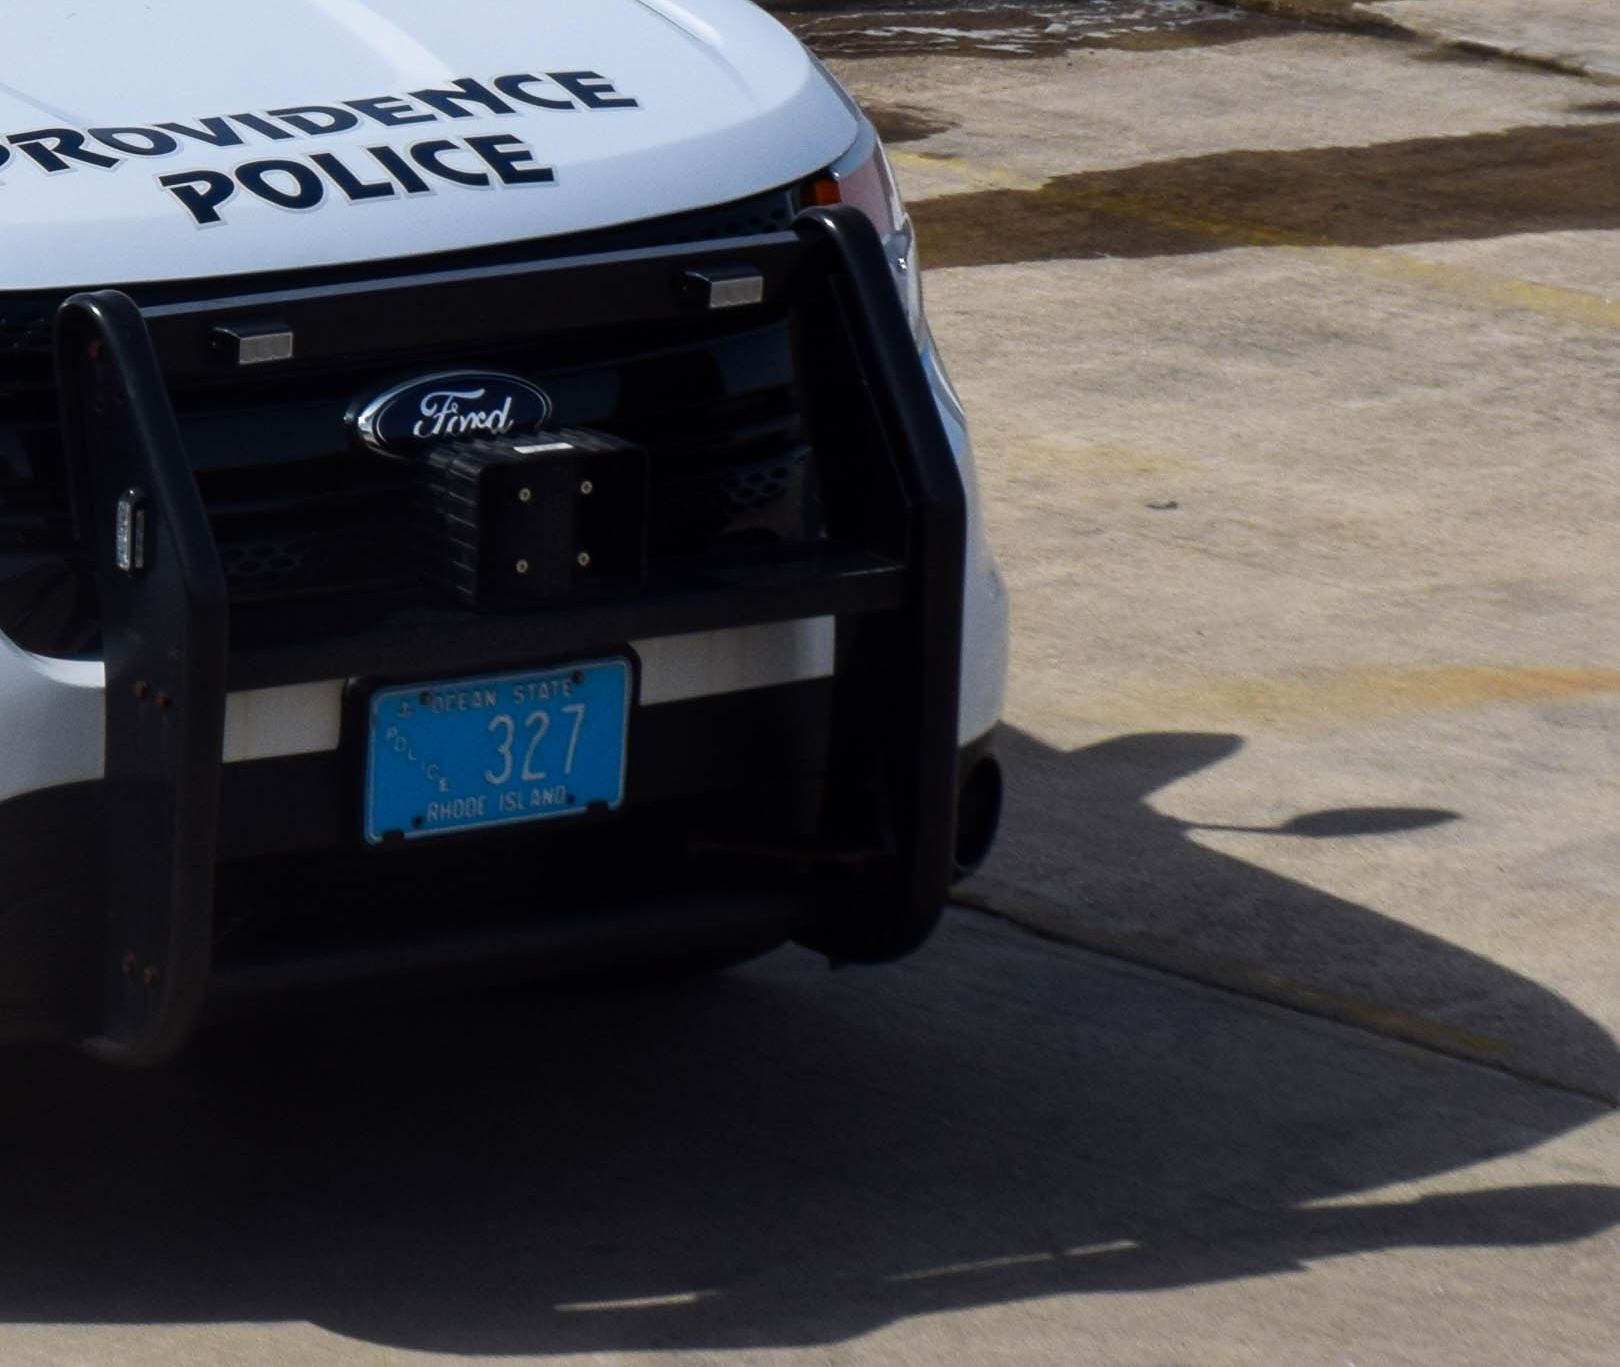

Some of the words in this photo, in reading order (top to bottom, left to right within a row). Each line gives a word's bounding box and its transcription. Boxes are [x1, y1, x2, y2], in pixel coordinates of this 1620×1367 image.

[158, 134, 556, 225] POLICE
[413, 388, 514, 438] Ford
[431, 690, 498, 713] OCEAN
[513, 679, 572, 704] STATE
[385, 725, 450, 793] POLICE
[485, 703, 585, 785] 327
[427, 794, 487, 823] RHODE
[499, 784, 567, 812] ISLAND
